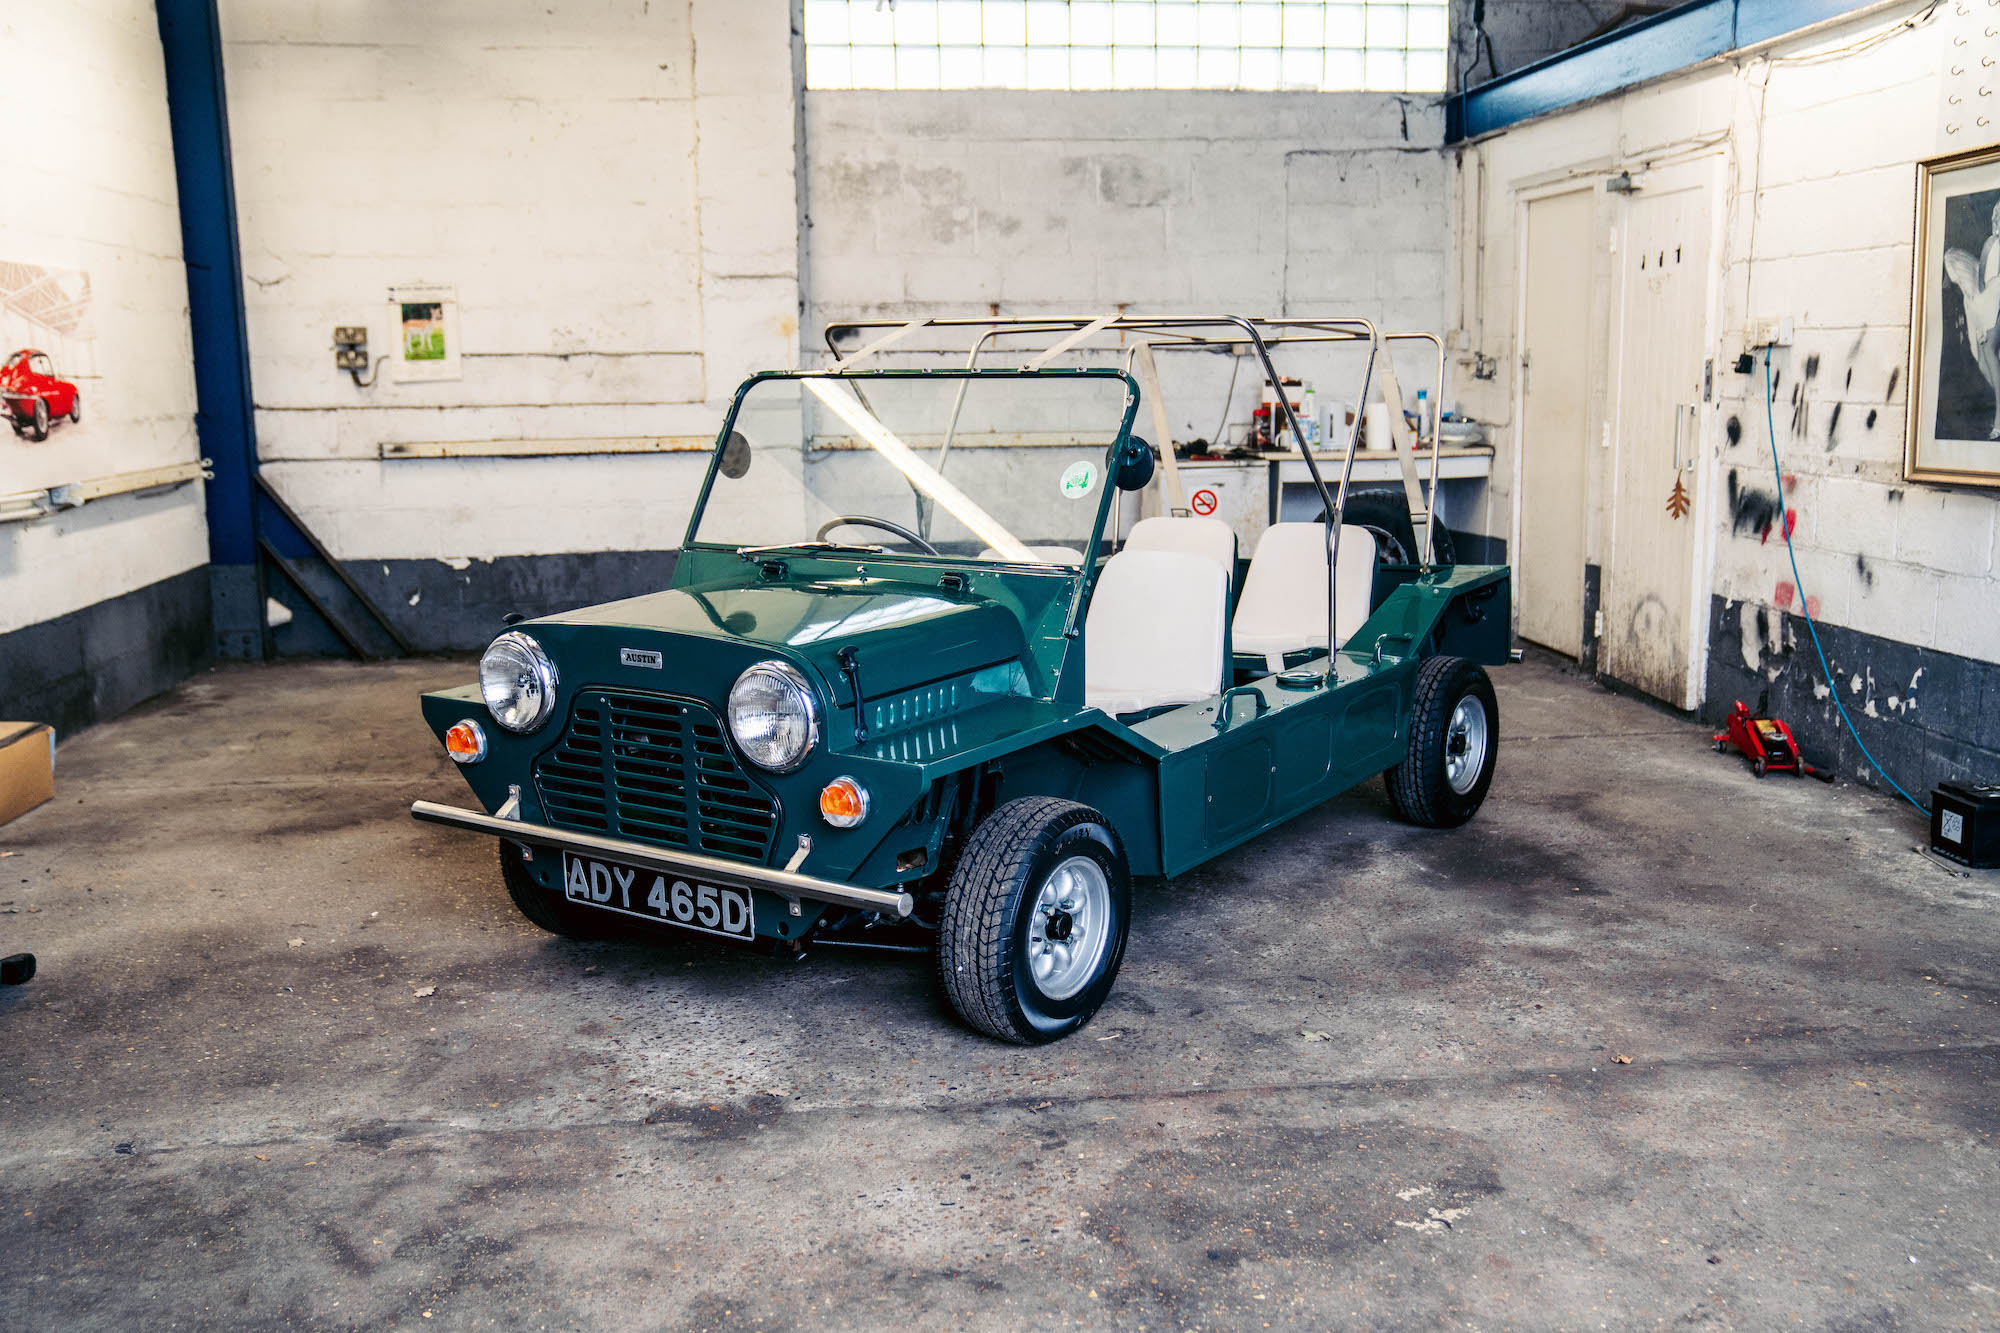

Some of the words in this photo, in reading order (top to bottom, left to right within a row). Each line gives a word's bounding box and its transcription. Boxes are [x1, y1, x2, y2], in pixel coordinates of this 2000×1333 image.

[625, 653, 656, 664] AUSTIN
[568, 857, 635, 908] ADY
[647, 875, 747, 933] 465D
